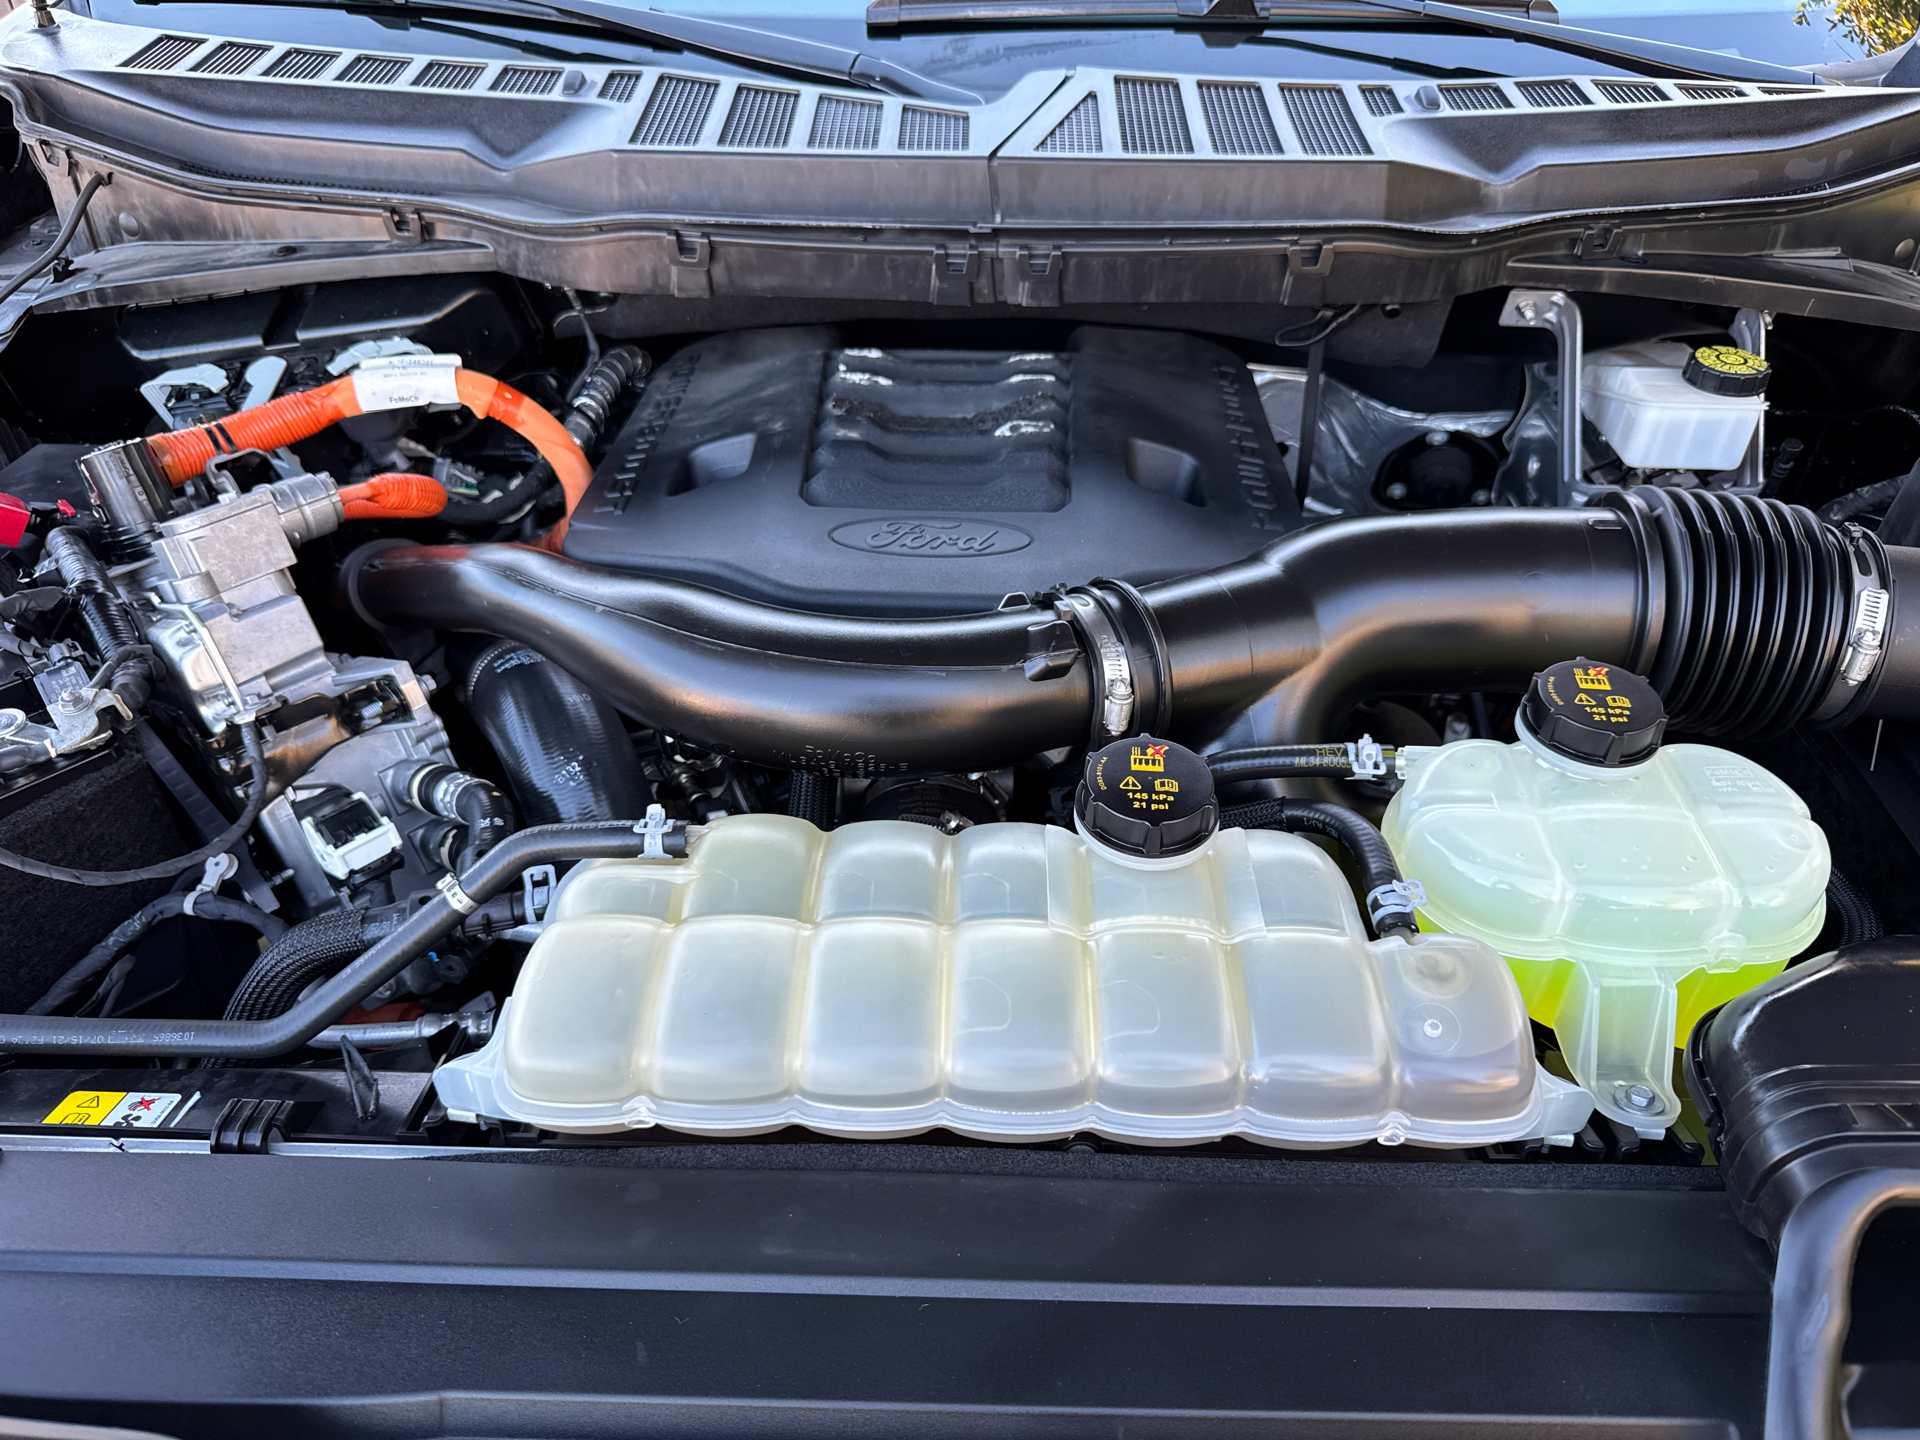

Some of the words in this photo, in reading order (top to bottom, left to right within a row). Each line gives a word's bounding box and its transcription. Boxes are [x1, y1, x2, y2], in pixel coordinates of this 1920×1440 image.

[389, 396, 420, 404] FoMoCo
[865, 521, 998, 552] Ford
[1585, 706, 1606, 714] 145
[1608, 707, 1631, 715] kPa
[1316, 748, 1344, 757] HEV
[1706, 768, 1750, 776] FoMoCo
[1127, 792, 1149, 800] 145
[1152, 793, 1175, 801] kPa
[1133, 801, 1147, 809] 21
[52, 1034, 104, 1045] 07/15/21
[152, 1031, 195, 1042] 1036865
